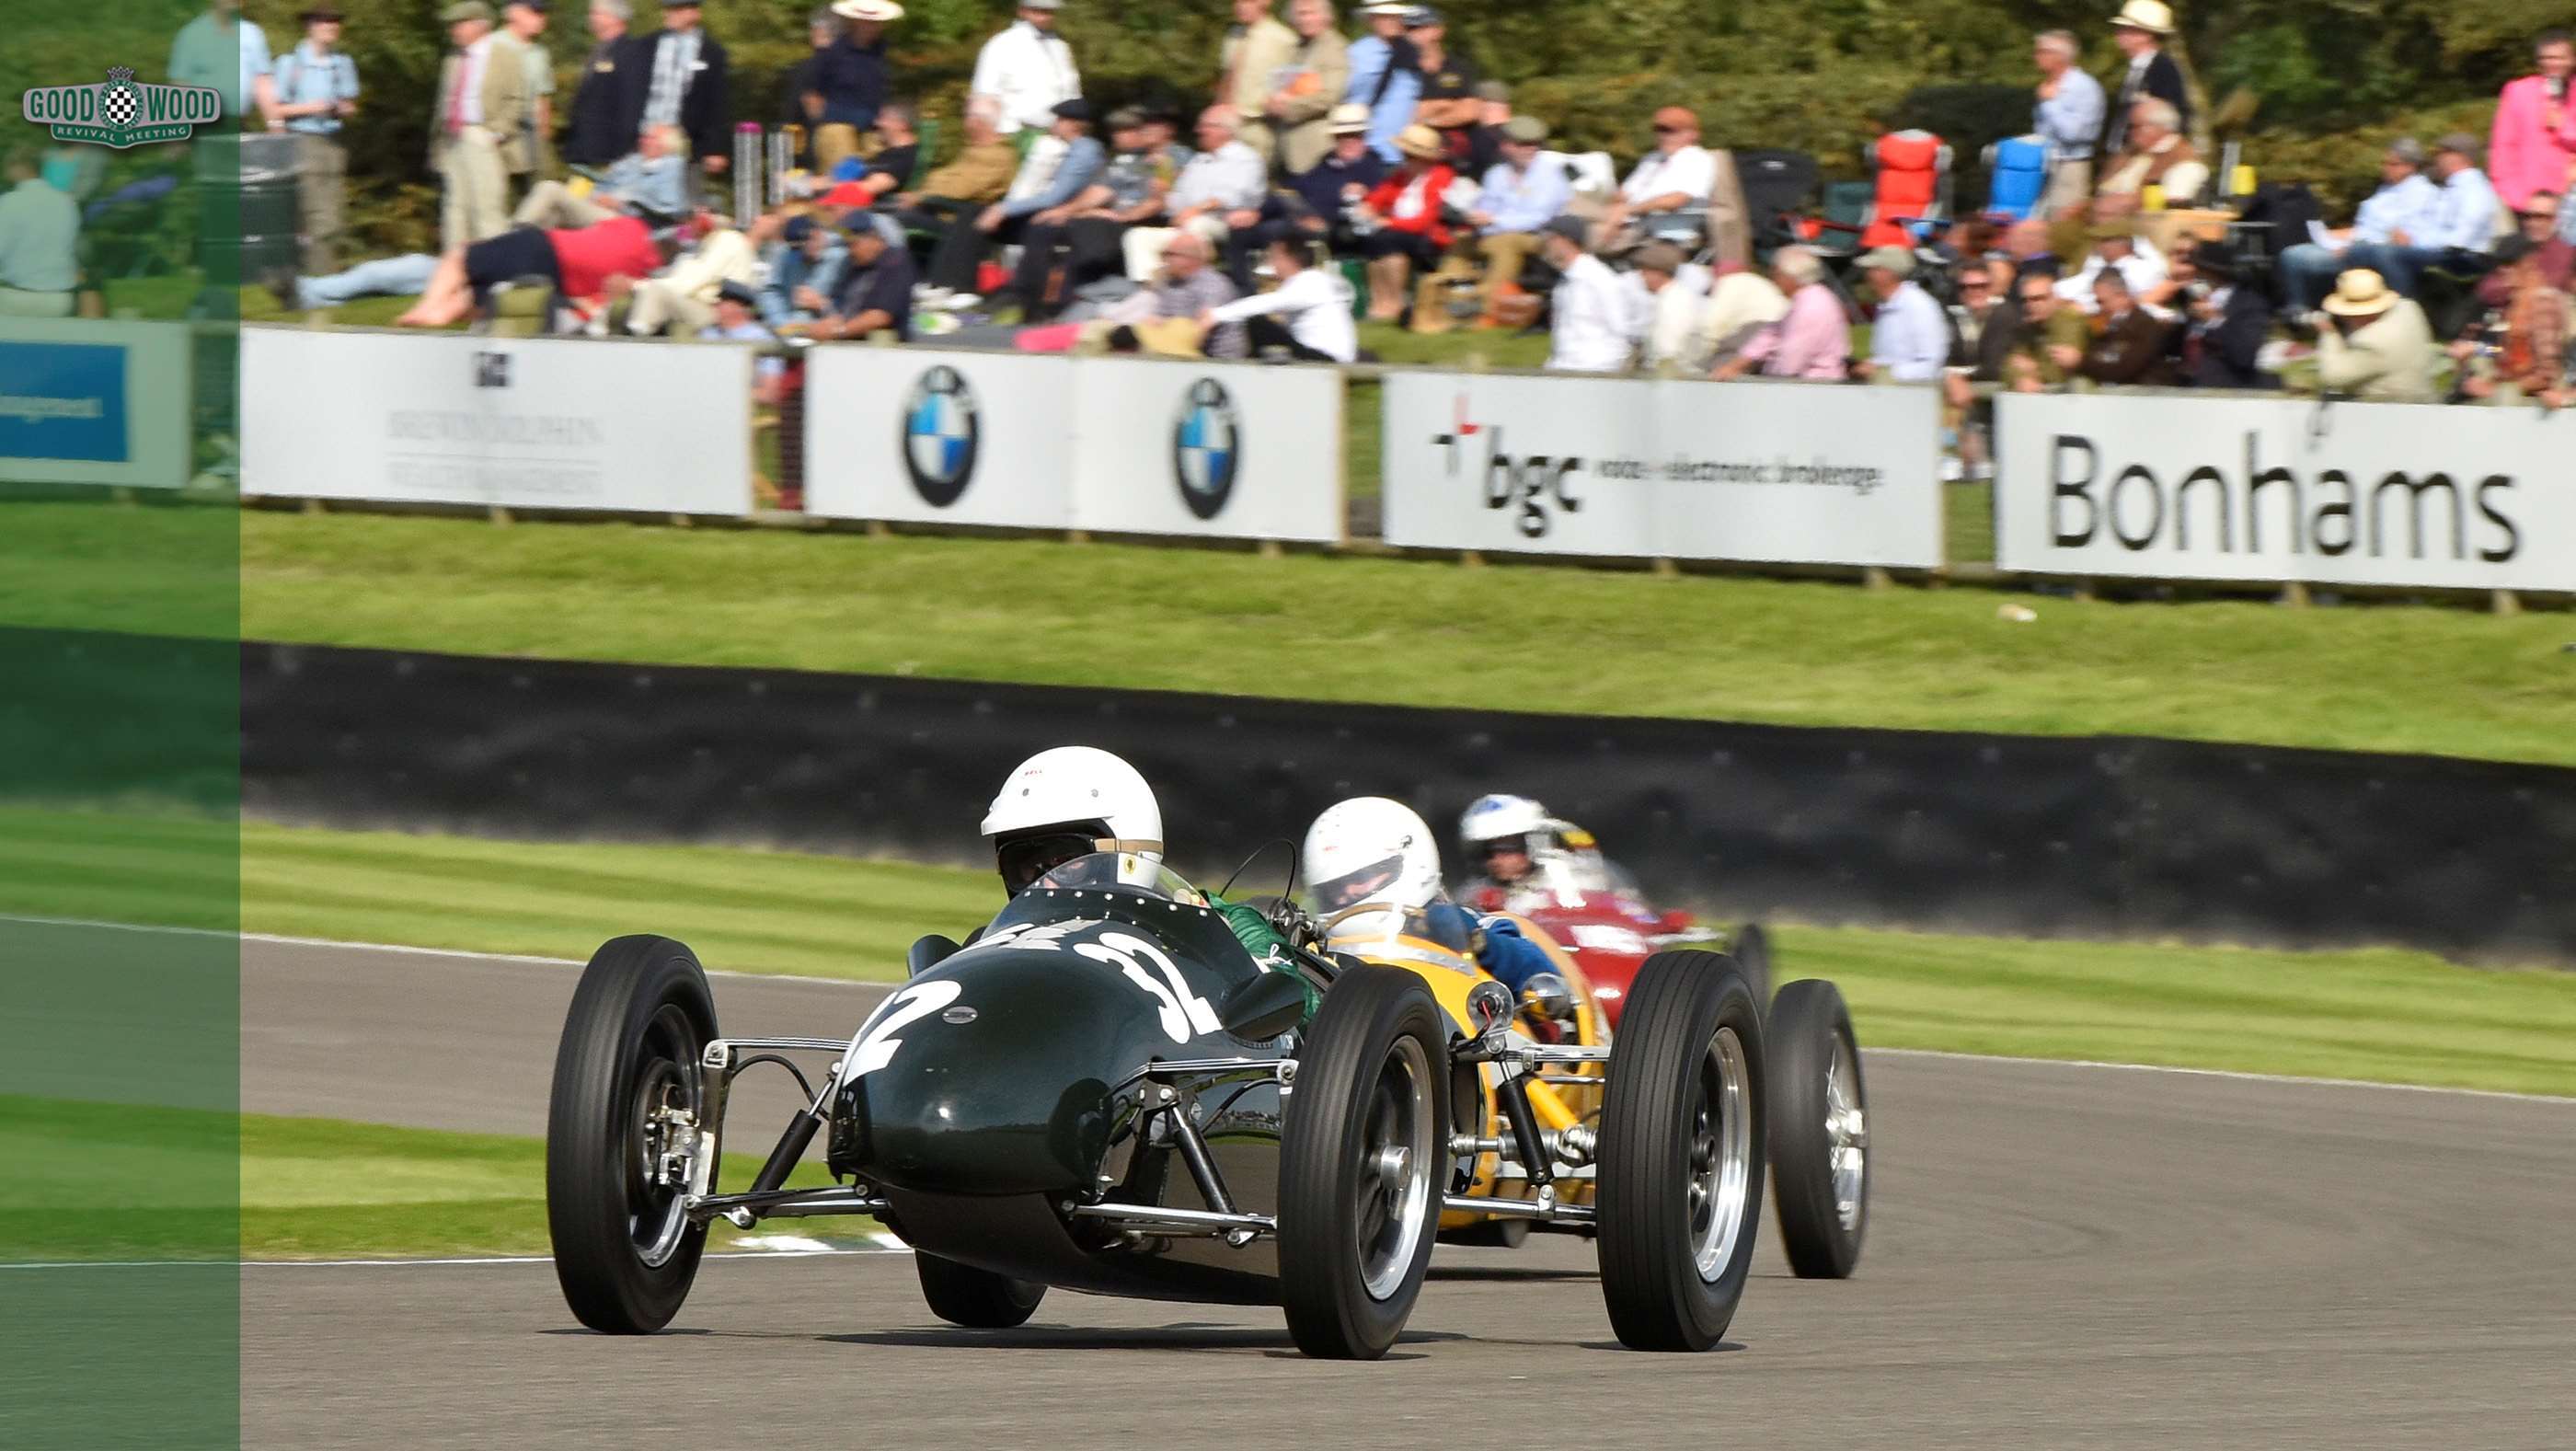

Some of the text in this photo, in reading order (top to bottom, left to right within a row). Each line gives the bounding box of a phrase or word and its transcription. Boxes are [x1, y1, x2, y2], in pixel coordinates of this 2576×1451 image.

[1484, 424, 1582, 538] bgc
[2051, 429, 2521, 563] Bonhams
[1073, 932, 1224, 1044] 32
